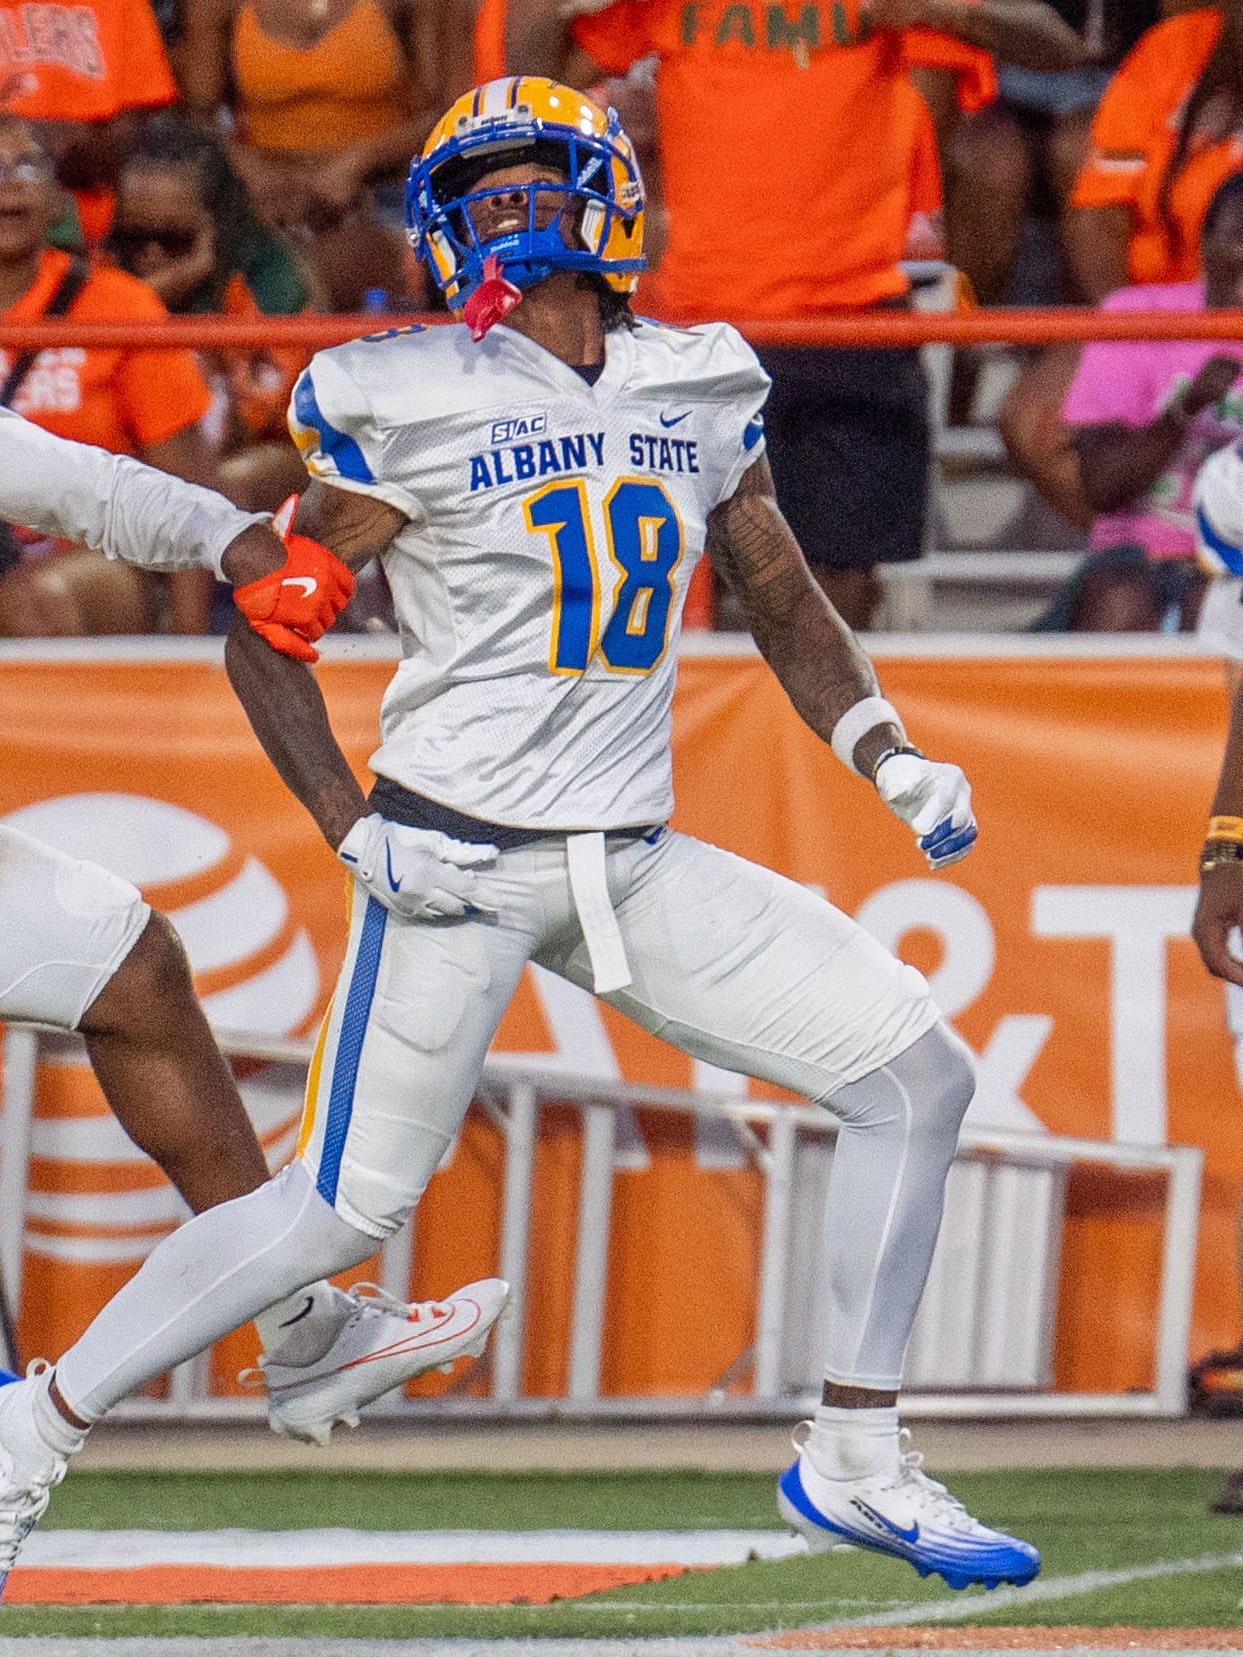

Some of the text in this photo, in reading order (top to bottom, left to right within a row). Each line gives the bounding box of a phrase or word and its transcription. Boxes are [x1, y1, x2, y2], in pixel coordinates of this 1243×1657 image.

[491, 413, 547, 444] SIAC
[470, 432, 700, 491] ALBANY STATE
[521, 476, 685, 677] 18
